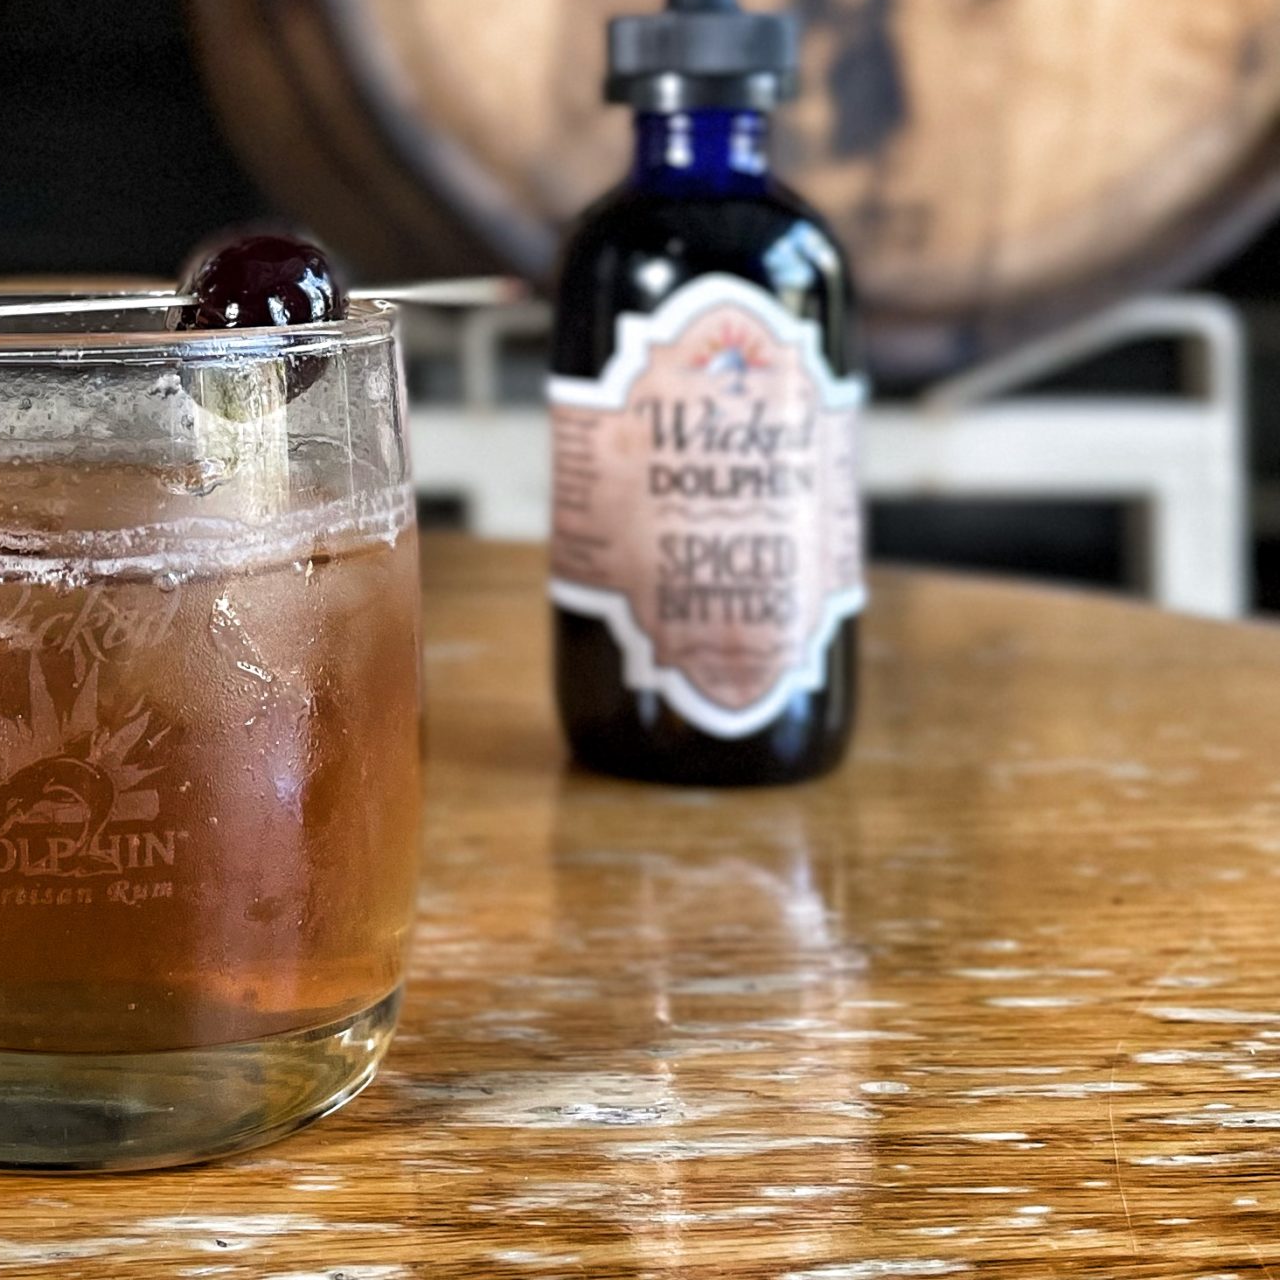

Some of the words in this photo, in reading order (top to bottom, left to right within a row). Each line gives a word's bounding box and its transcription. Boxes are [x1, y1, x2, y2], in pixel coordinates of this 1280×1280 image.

[632, 396, 817, 459] Wicked
[649, 463, 814, 497] DOLPHIN
[658, 532, 797, 580] SPICED
[106, 879, 173, 907] Rum
